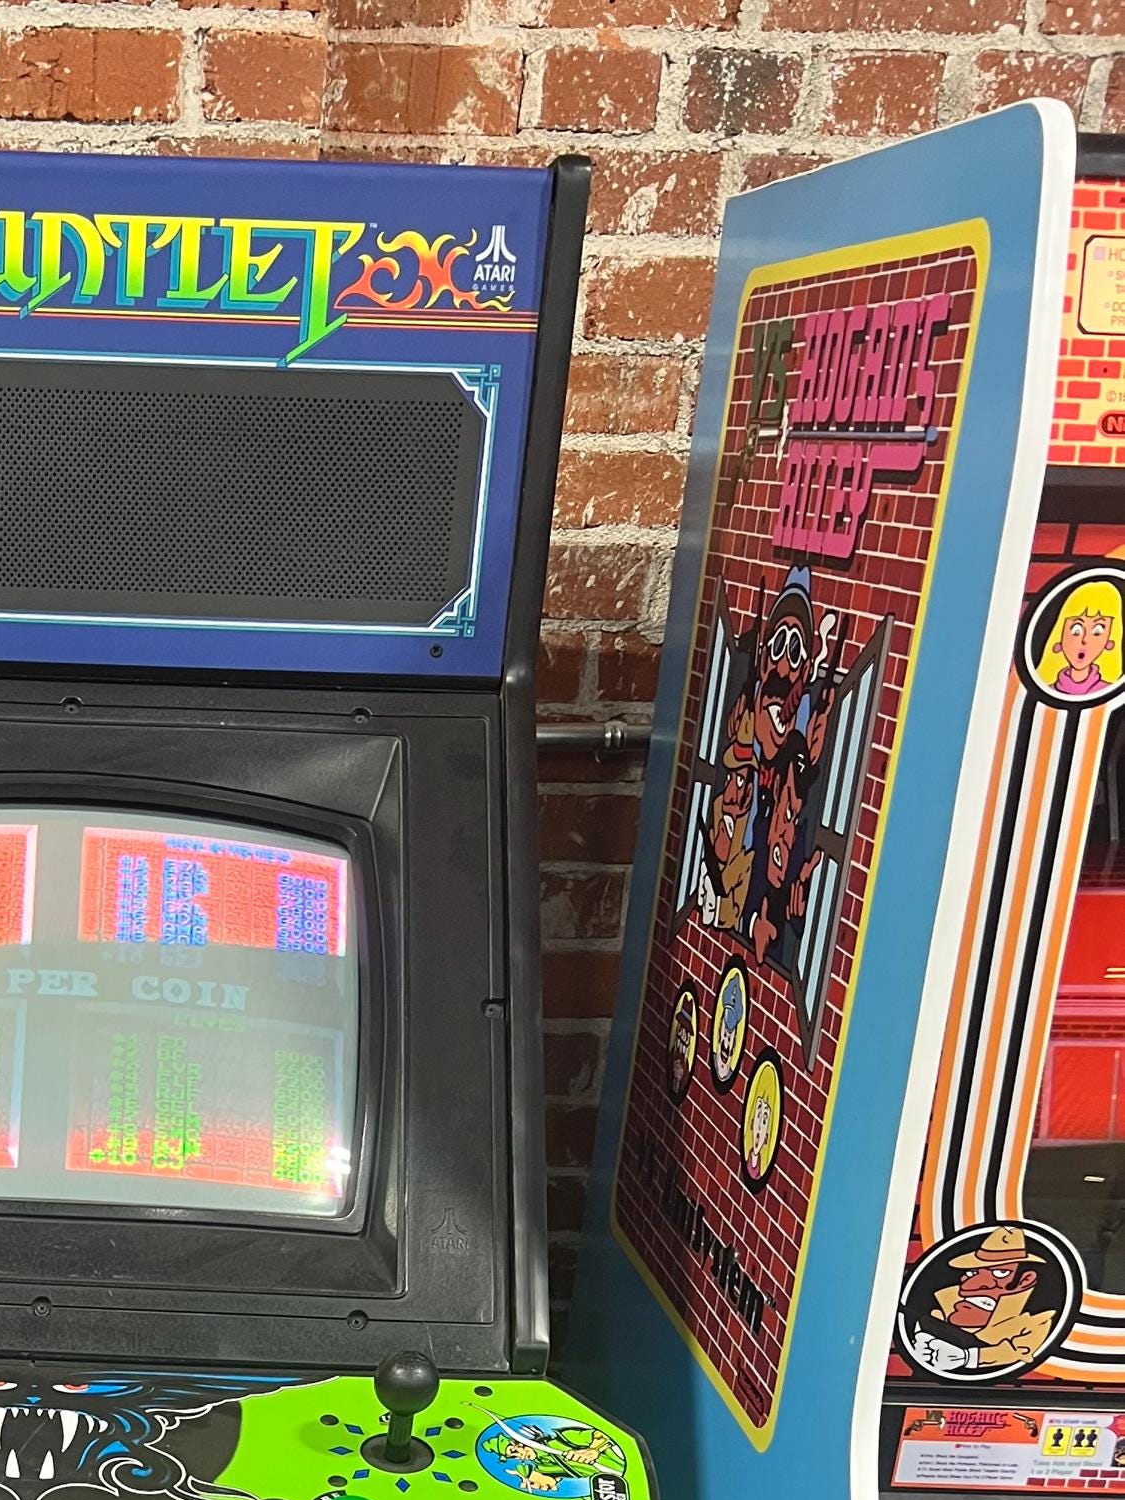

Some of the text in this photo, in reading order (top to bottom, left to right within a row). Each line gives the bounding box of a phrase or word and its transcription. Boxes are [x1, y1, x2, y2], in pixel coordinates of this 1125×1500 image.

[473, 264, 515, 282] ATARI
[472, 283, 515, 292] GAMES
[6, 968, 98, 997] PER
[132, 975, 249, 1011] COIN
